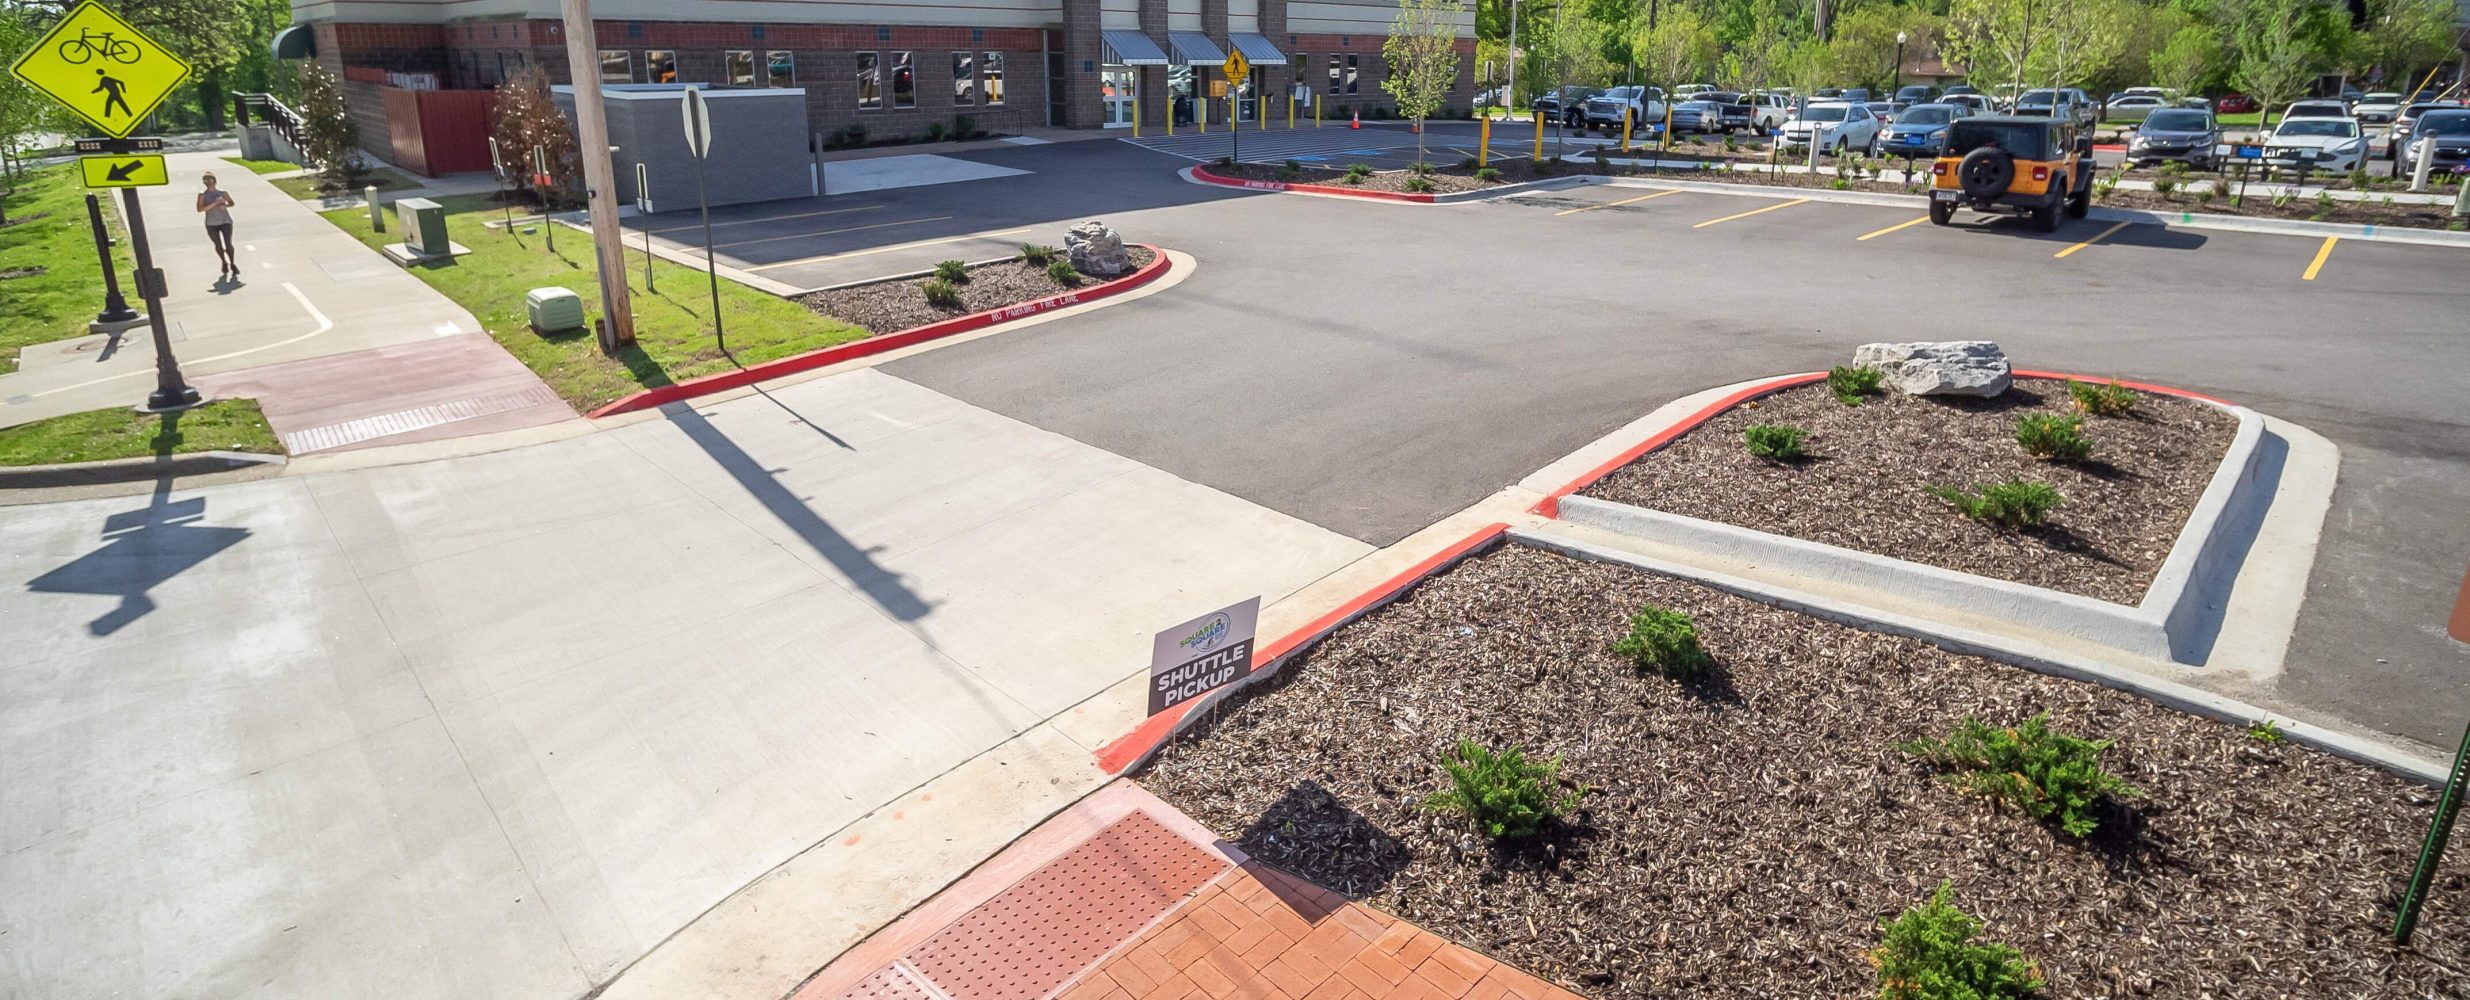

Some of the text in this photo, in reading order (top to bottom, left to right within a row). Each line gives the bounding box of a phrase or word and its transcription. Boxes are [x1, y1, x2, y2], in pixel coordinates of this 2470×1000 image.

[991, 295, 1079, 322] NO PARKING FIRE LANE
[1179, 622, 1215, 648] SQUARE
[1215, 618, 1222, 627] 2
[1190, 623, 1226, 648] SQUARE
[1158, 644, 1245, 692] SHUTTLE
[1164, 666, 1235, 707] PICKUP
